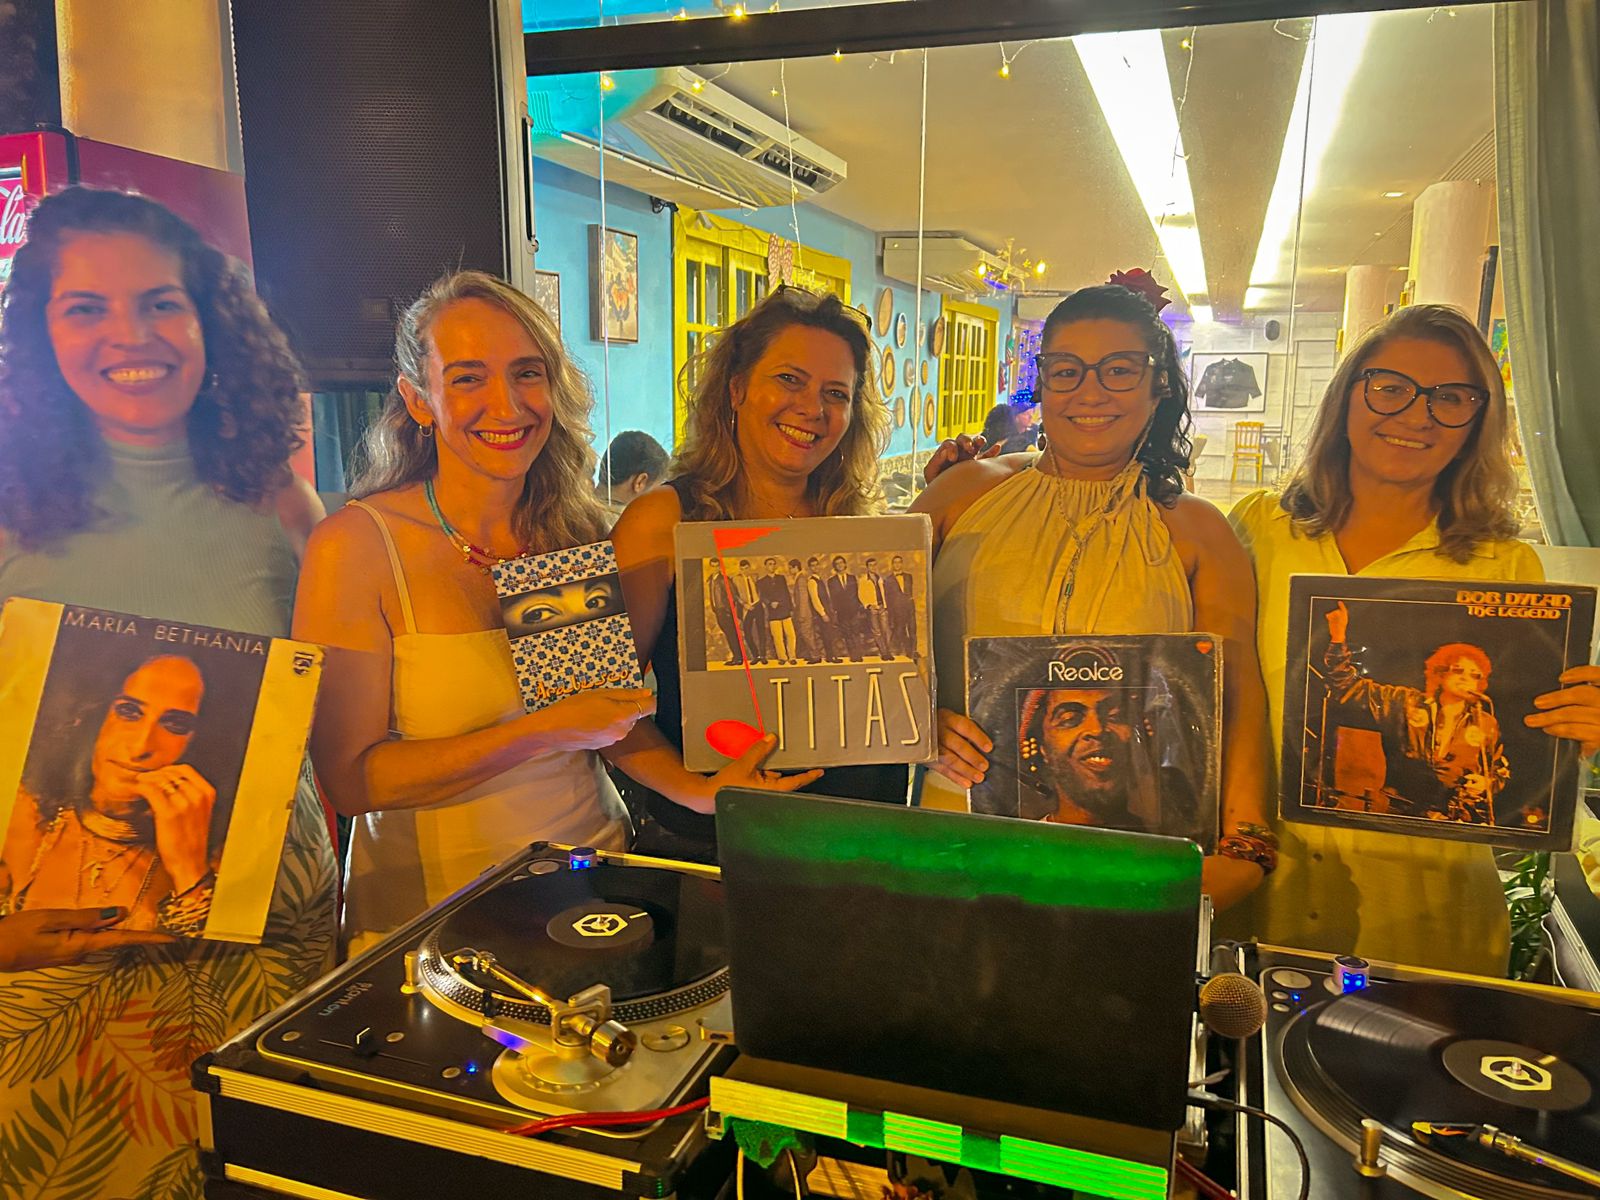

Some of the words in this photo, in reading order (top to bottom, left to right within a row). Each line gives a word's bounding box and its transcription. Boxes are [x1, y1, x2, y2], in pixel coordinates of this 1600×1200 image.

[1456, 590, 1501, 605] BOB
[1505, 592, 1572, 608] DYLAN
[1467, 605, 1496, 618] THE
[1498, 606, 1561, 620] LEGEND
[64, 611, 138, 635] MARIA
[154, 624, 265, 656] BETHÂNIA
[1048, 661, 1123, 681] Realce
[769, 667, 920, 751] TITÃS
